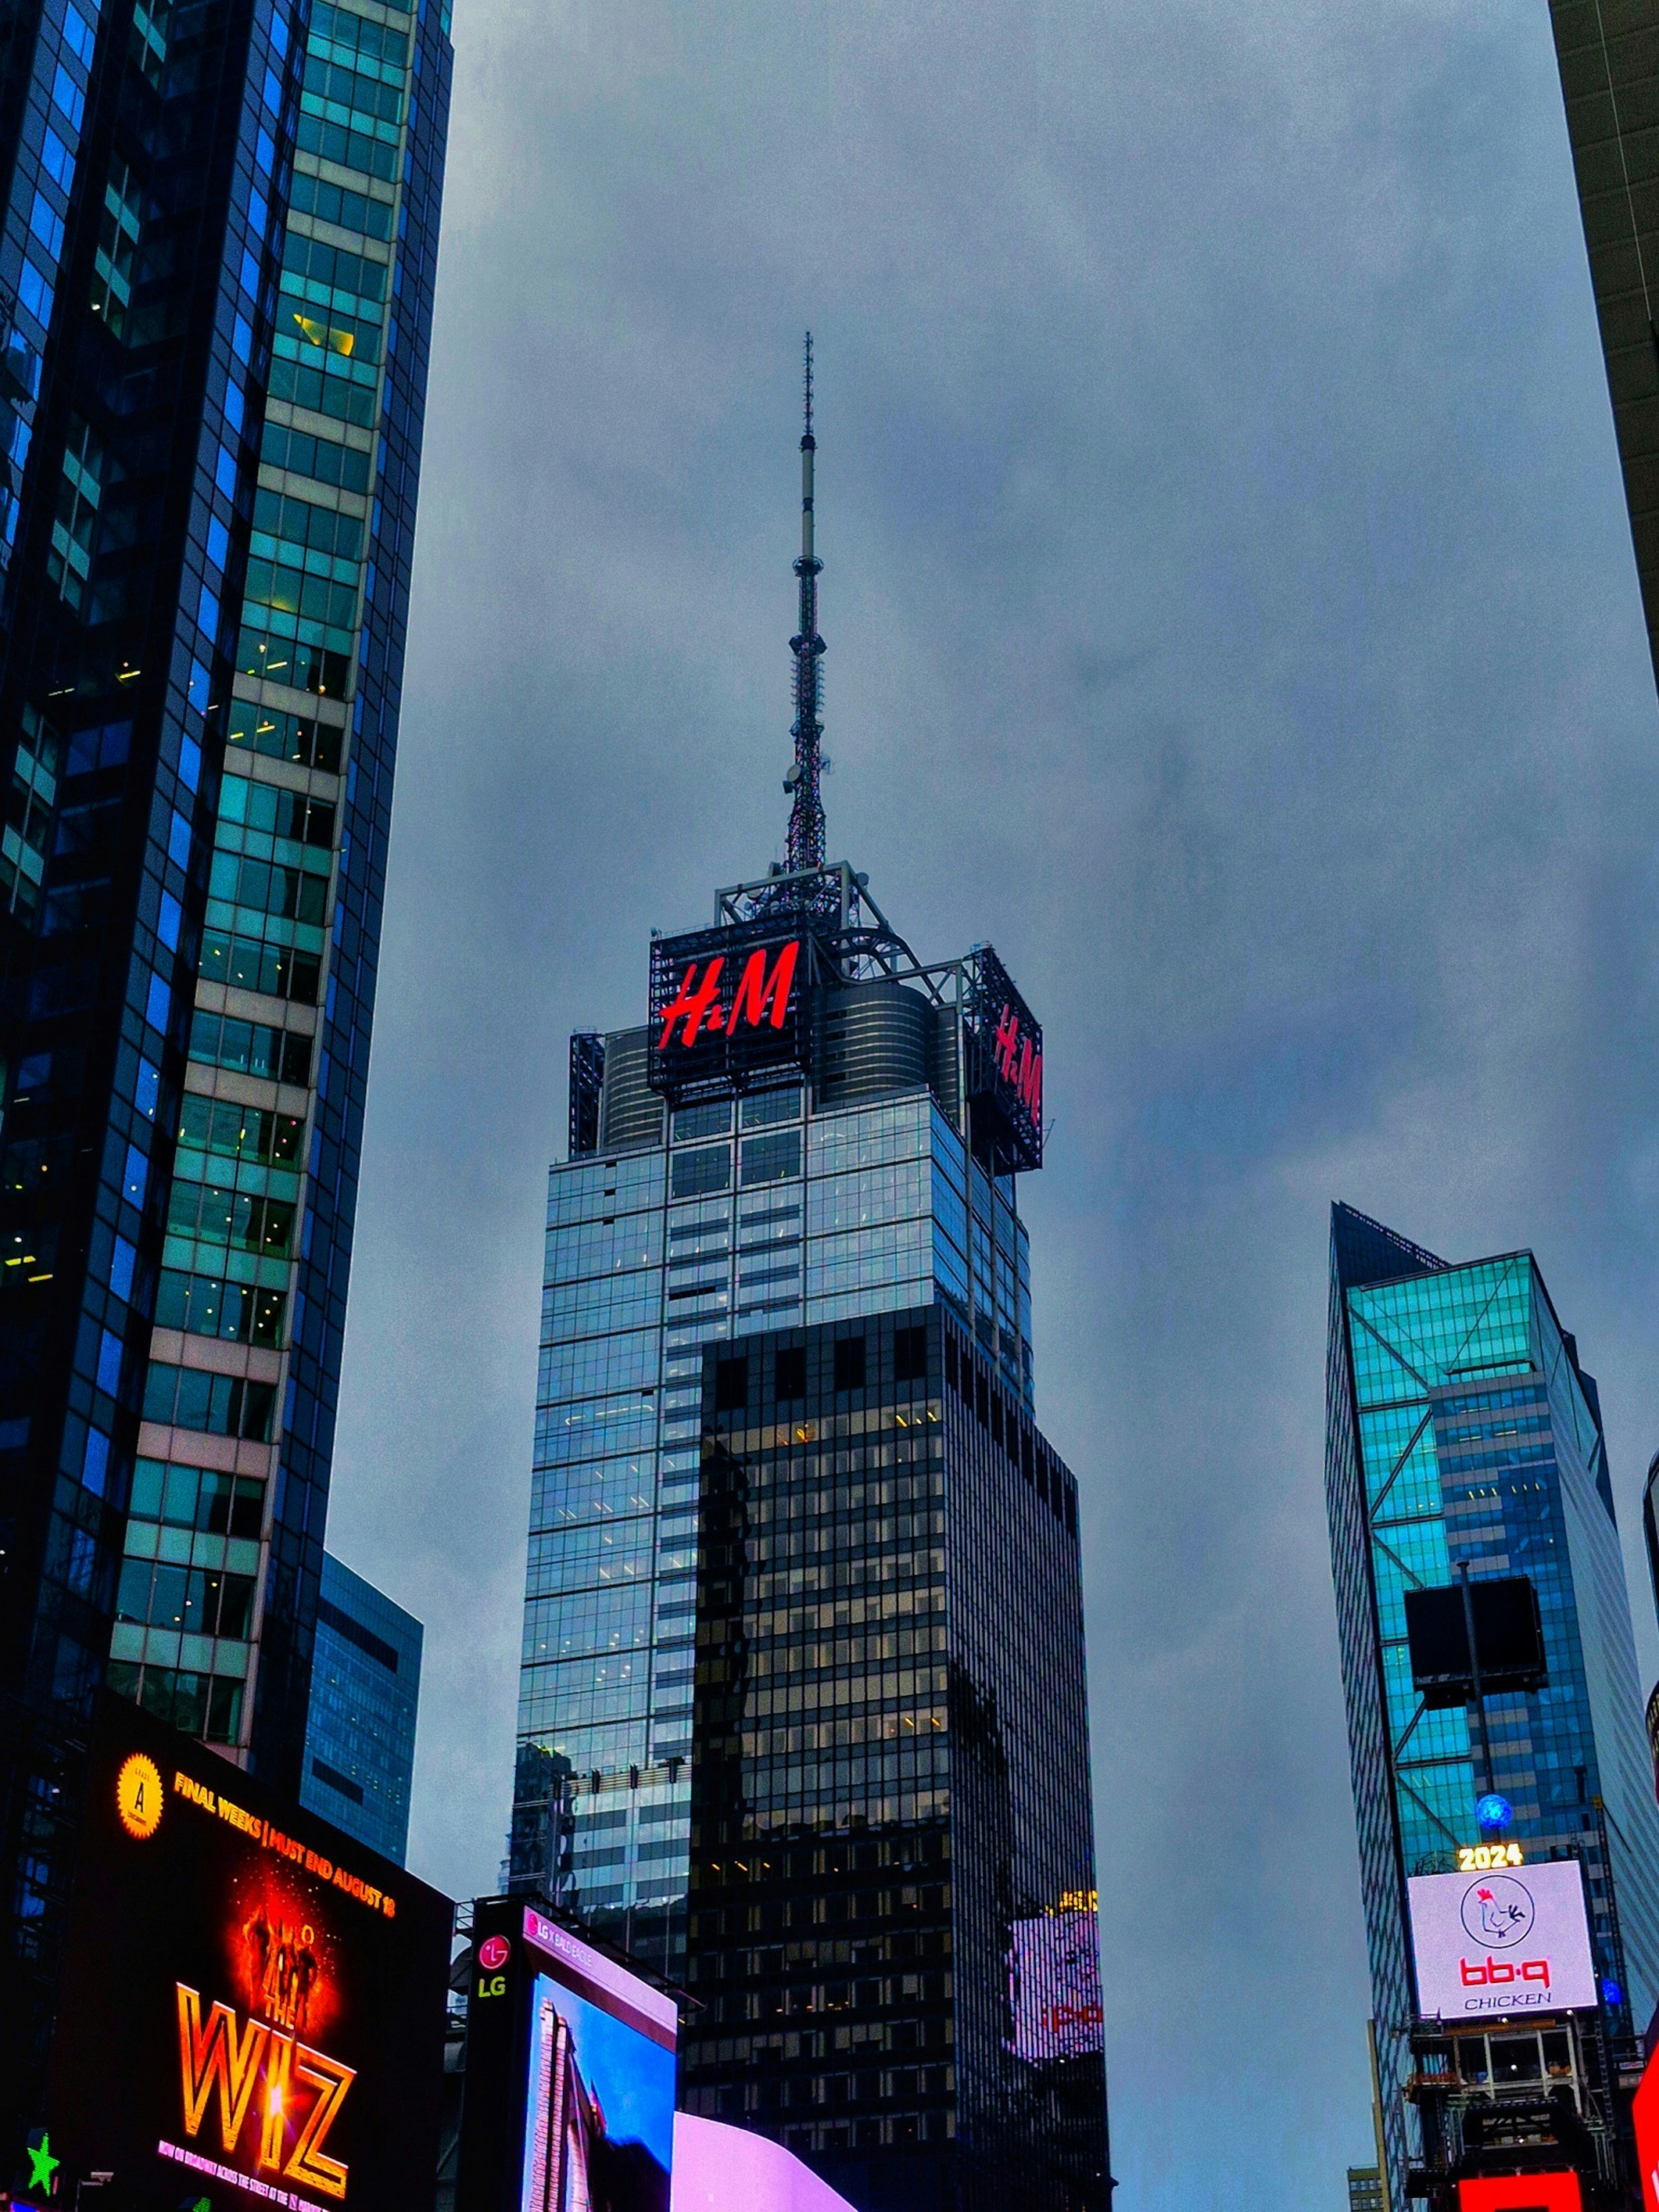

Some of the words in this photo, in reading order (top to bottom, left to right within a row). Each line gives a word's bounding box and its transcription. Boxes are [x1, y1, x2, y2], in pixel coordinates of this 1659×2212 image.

[659, 941, 800, 1049] H&M
[134, 1782, 144, 1812] A
[174, 1771, 216, 1813] FINAL
[217, 1796, 262, 1839] WEEKS
[269, 1828, 305, 1864] MUST
[306, 1850, 333, 1880] END
[332, 1867, 383, 1909] AUGUST
[1459, 1843, 1524, 1872] 2024
[537, 1920, 549, 1941] LG
[478, 1976, 507, 1998] LG
[1464, 1992, 1552, 2010] CHICKEN
[176, 1981, 358, 2201] WIZ
